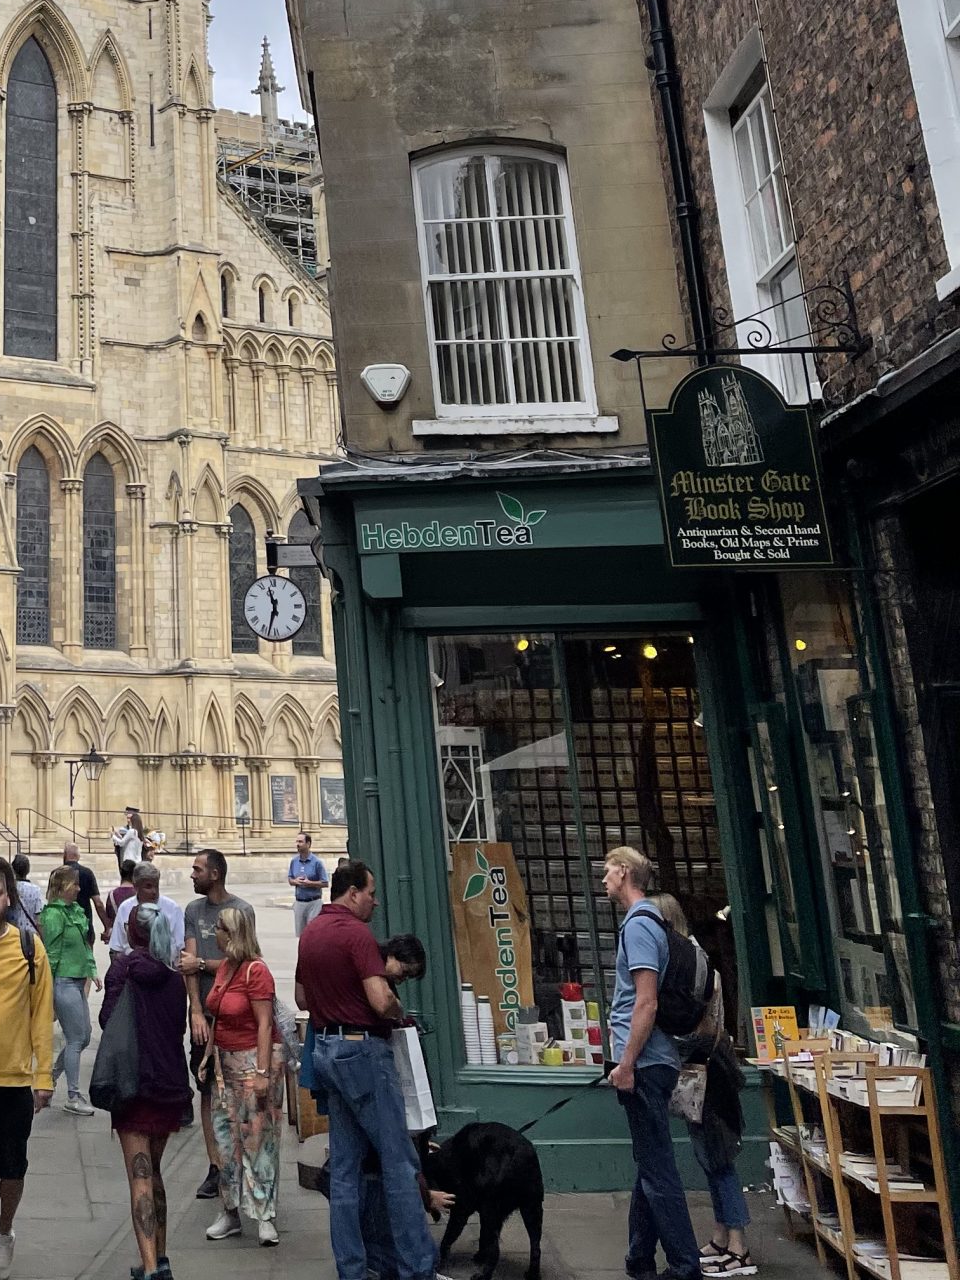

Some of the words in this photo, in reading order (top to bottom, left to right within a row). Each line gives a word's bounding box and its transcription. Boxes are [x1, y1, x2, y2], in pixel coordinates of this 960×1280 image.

[671, 470, 754, 496] Minster
[761, 469, 811, 492] Gate
[684, 497, 741, 523] Book
[748, 496, 805, 522] Shop
[360, 519, 533, 550] HebdenTea
[677, 526, 738, 538] Antiquarian
[741, 525, 753, 536] &
[754, 524, 792, 535] Second
[793, 524, 821, 535] hand
[681, 538, 718, 549] Books,
[720, 537, 739, 548] Old
[740, 537, 771, 549] Maps
[772, 536, 785, 547] &
[786, 536, 819, 547] Prints
[713, 549, 751, 561] Bought
[753, 549, 766, 559] &
[767, 548, 790, 559] Sold
[489, 866, 522, 1032] ebdenTea
